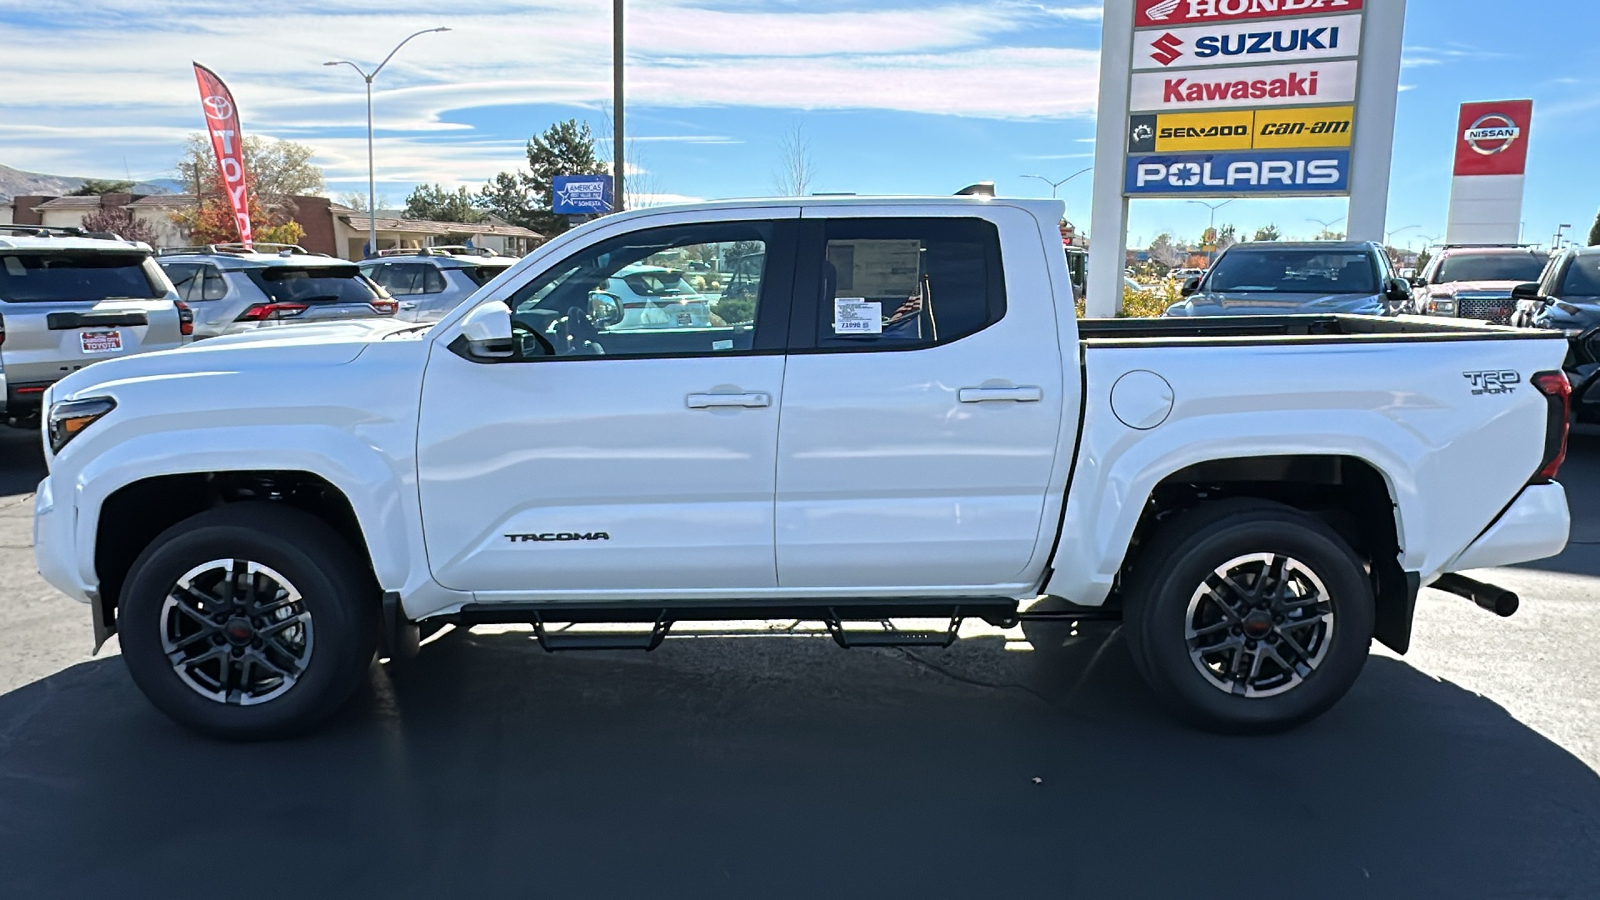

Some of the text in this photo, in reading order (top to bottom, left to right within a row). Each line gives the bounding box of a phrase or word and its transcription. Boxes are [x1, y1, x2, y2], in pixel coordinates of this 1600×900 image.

[1194, 26, 1339, 58] SUZUKI
[1163, 70, 1319, 102] Kawasaki
[1260, 120, 1350, 136] can-am
[1469, 129, 1514, 138] NISSAN
[1136, 159, 1340, 187] POLARIS
[1463, 369, 1521, 389] TRD
[504, 531, 610, 543] TACOMA
